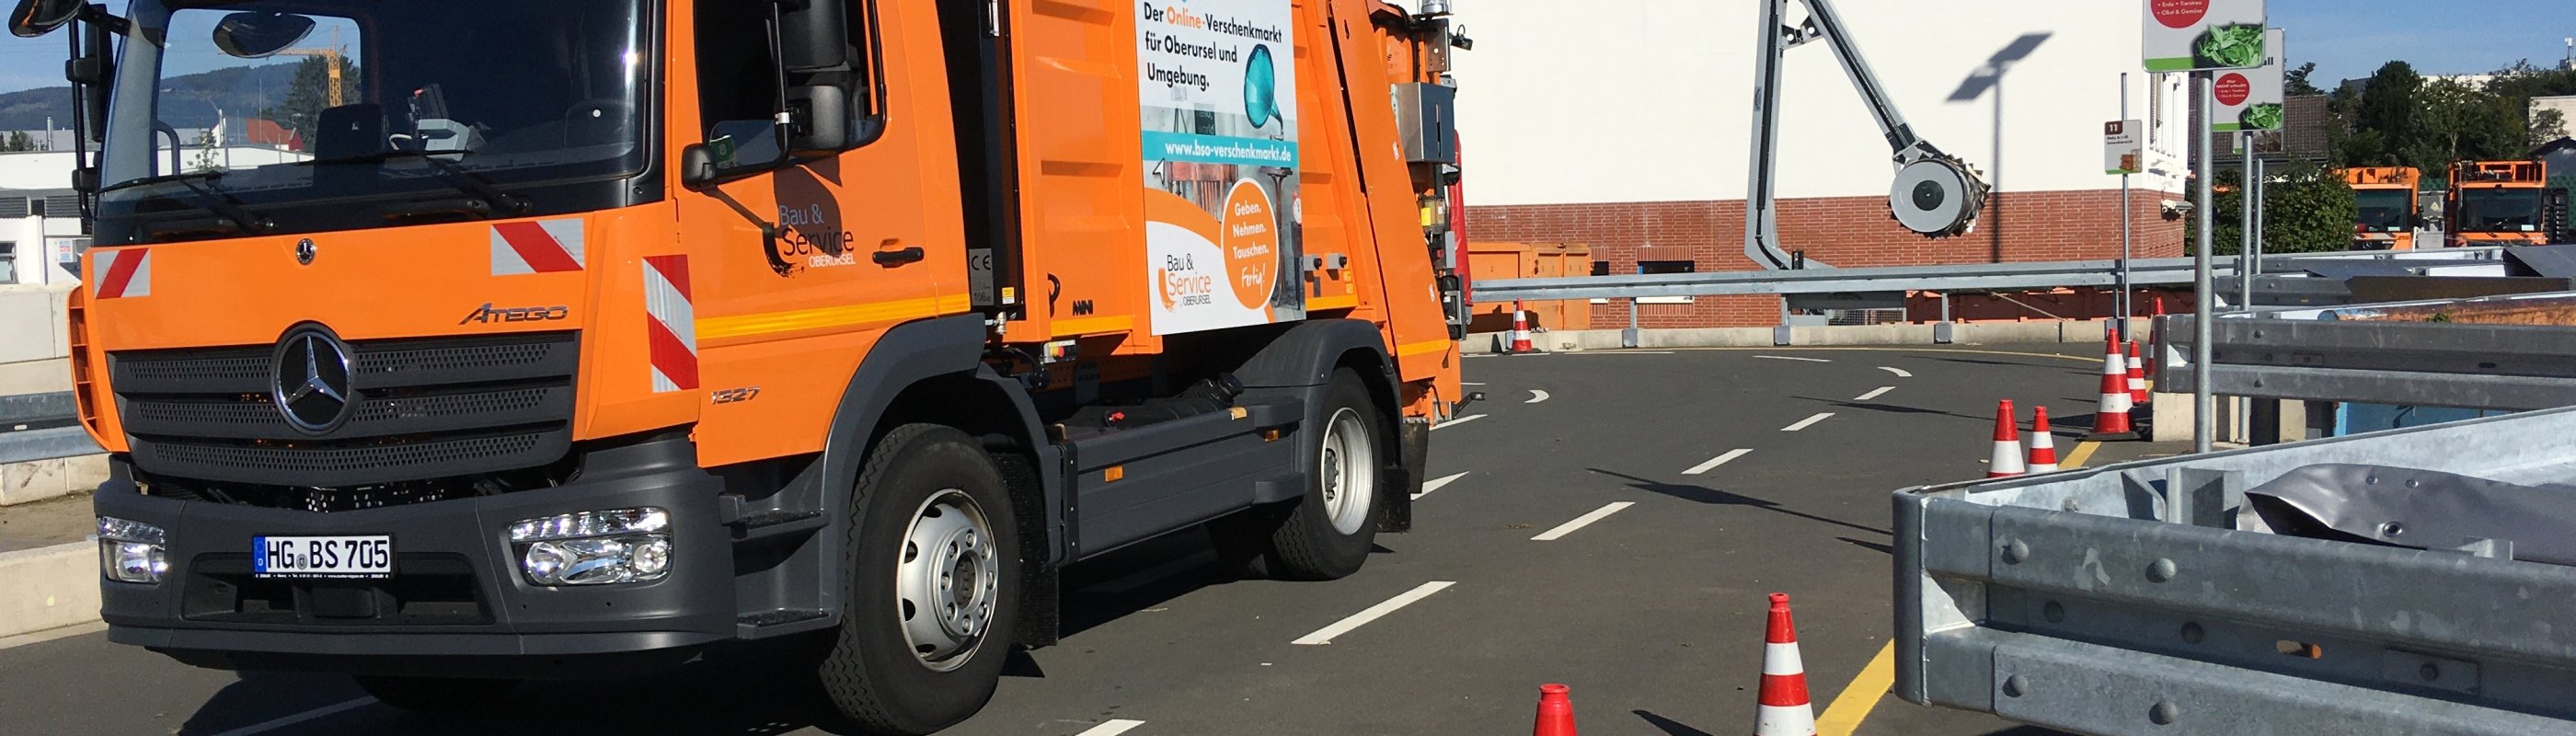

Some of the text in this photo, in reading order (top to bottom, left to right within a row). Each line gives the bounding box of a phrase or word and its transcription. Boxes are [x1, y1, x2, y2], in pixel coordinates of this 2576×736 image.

[1144, 2, 1282, 43] Der Online-Verschenkmarkt
[1144, 30, 1237, 63] für Oberursel und
[1147, 62, 1210, 92] Umgebung.
[2110, 123, 2118, 132] 11
[1165, 139, 1292, 162] www.bso-verschenkmarkt.de
[779, 203, 824, 226] Bau &
[1234, 201, 1262, 217] Geben.
[1233, 223, 1267, 237] Nehmen.
[782, 226, 855, 256] Service
[1233, 242, 1270, 259] Tauschen.
[809, 253, 856, 268] OBERURSEL
[971, 255, 991, 270] CE
[1167, 253, 1194, 271] Bau &
[1167, 272, 1212, 296] Service
[1182, 294, 1212, 306] OBERURSEL
[711, 386, 760, 405] 1327
[267, 540, 294, 569] HG
[310, 540, 339, 569] BS
[345, 539, 388, 569] 705
